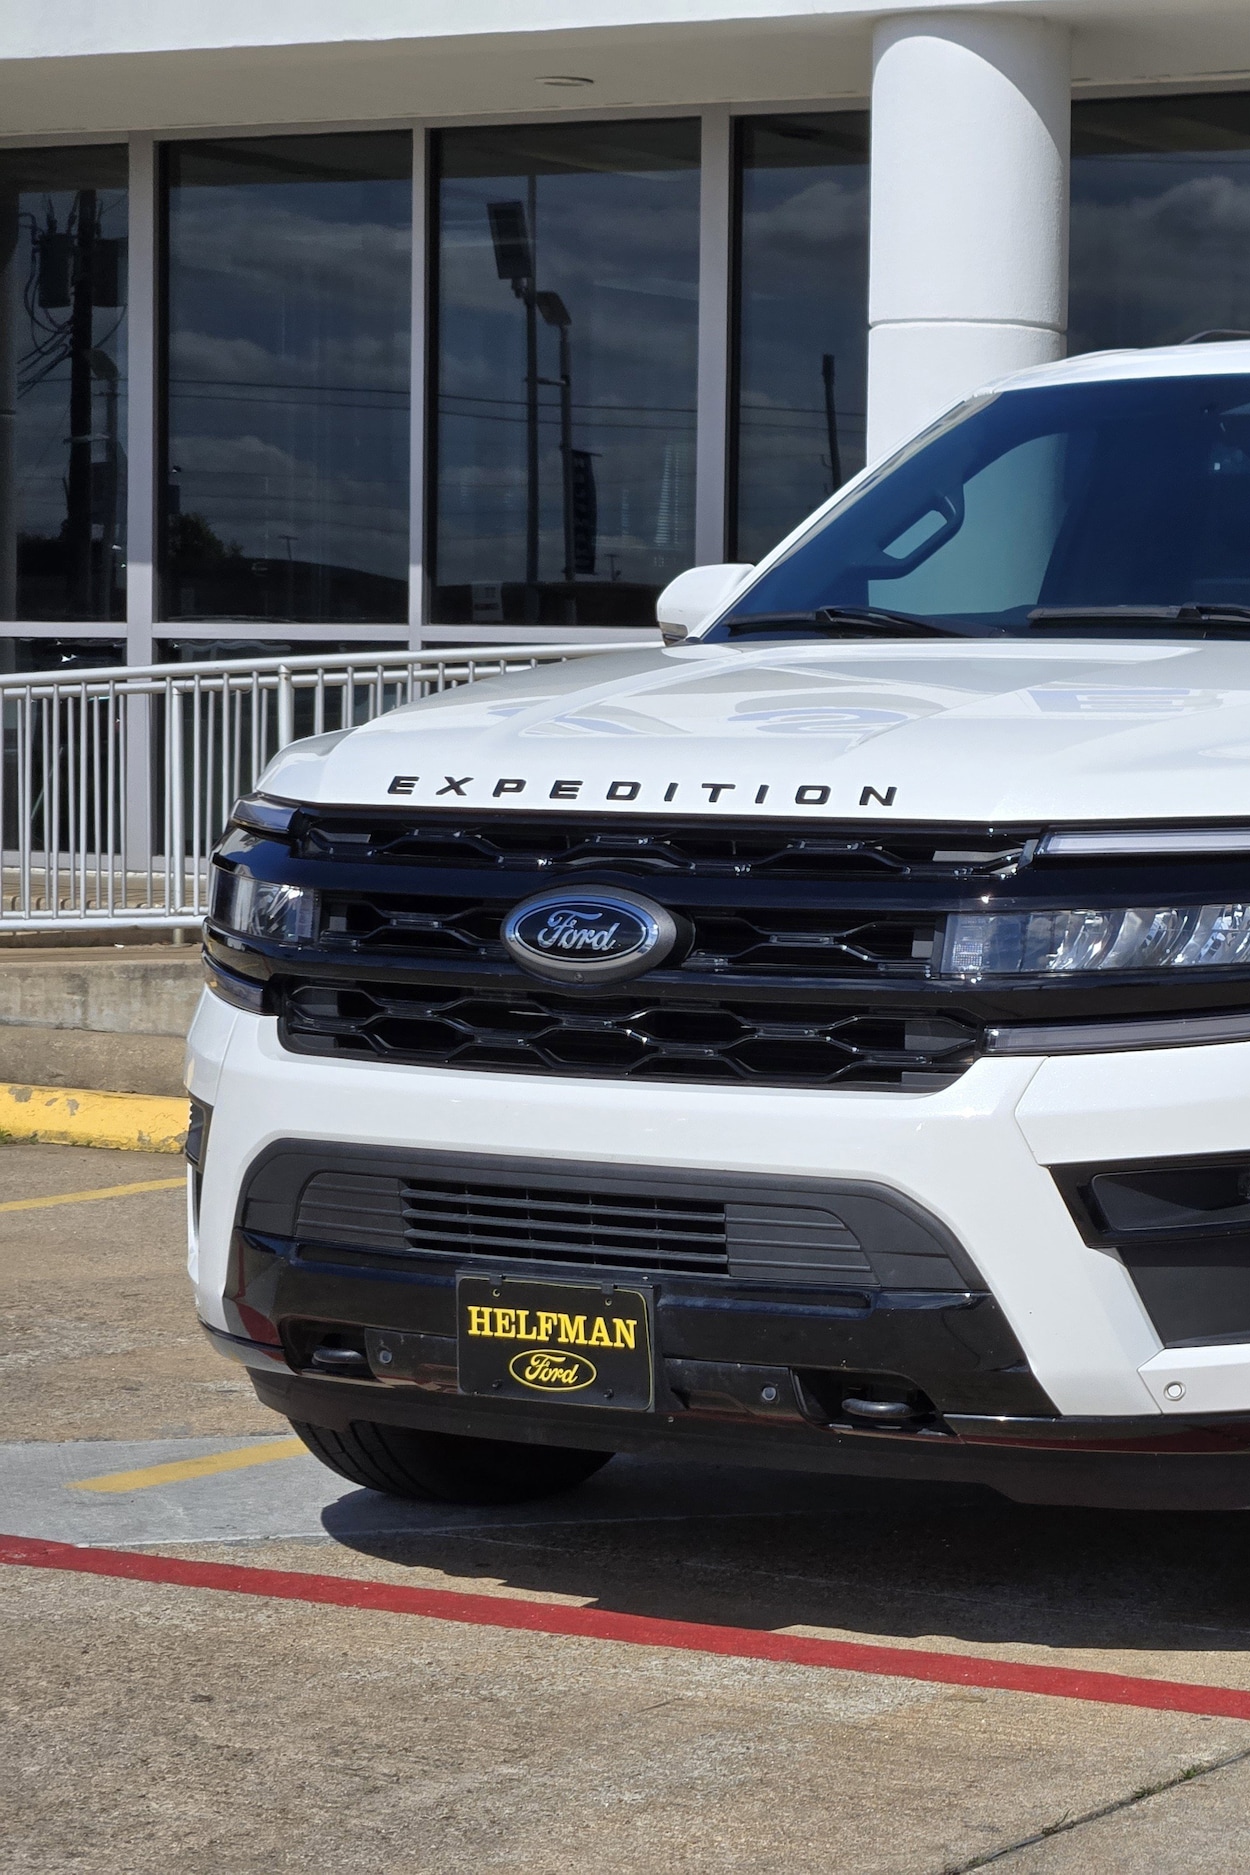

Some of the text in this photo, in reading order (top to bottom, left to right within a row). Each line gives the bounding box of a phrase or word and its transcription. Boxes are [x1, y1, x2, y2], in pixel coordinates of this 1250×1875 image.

[387, 775, 898, 807] EXPEDITION
[536, 909, 618, 953] Ford
[467, 1305, 637, 1349] HELFMAN
[524, 1353, 580, 1385] Ford
